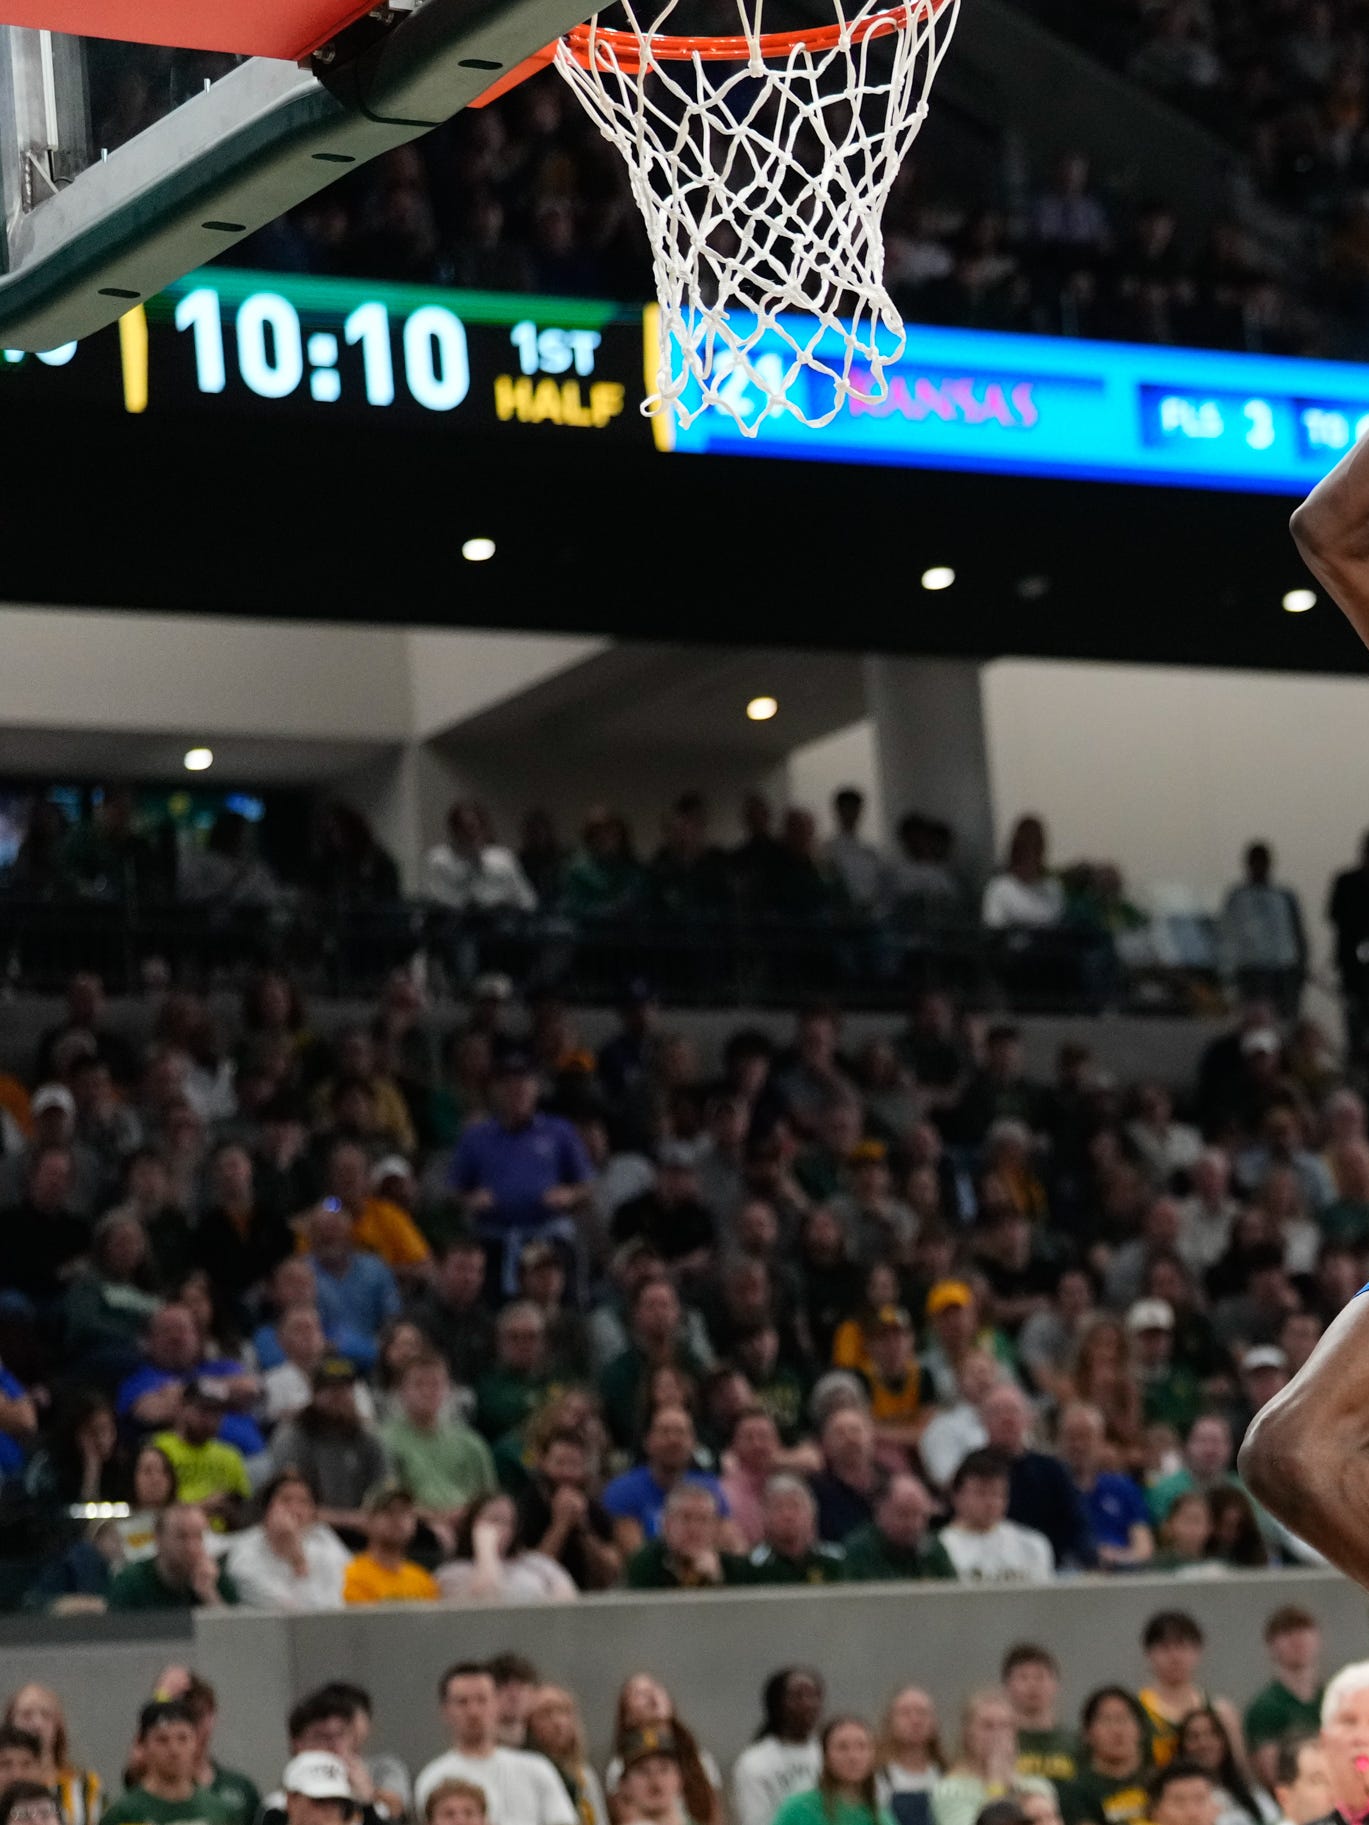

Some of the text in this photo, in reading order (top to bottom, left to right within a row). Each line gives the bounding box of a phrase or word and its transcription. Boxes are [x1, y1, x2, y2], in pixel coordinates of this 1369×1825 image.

[174, 288, 470, 411] 10:10
[510, 320, 602, 376] 1ST
[494, 374, 625, 428] HALF
[848, 366, 1039, 428] KANSAS
[1244, 399, 1275, 450] 3
